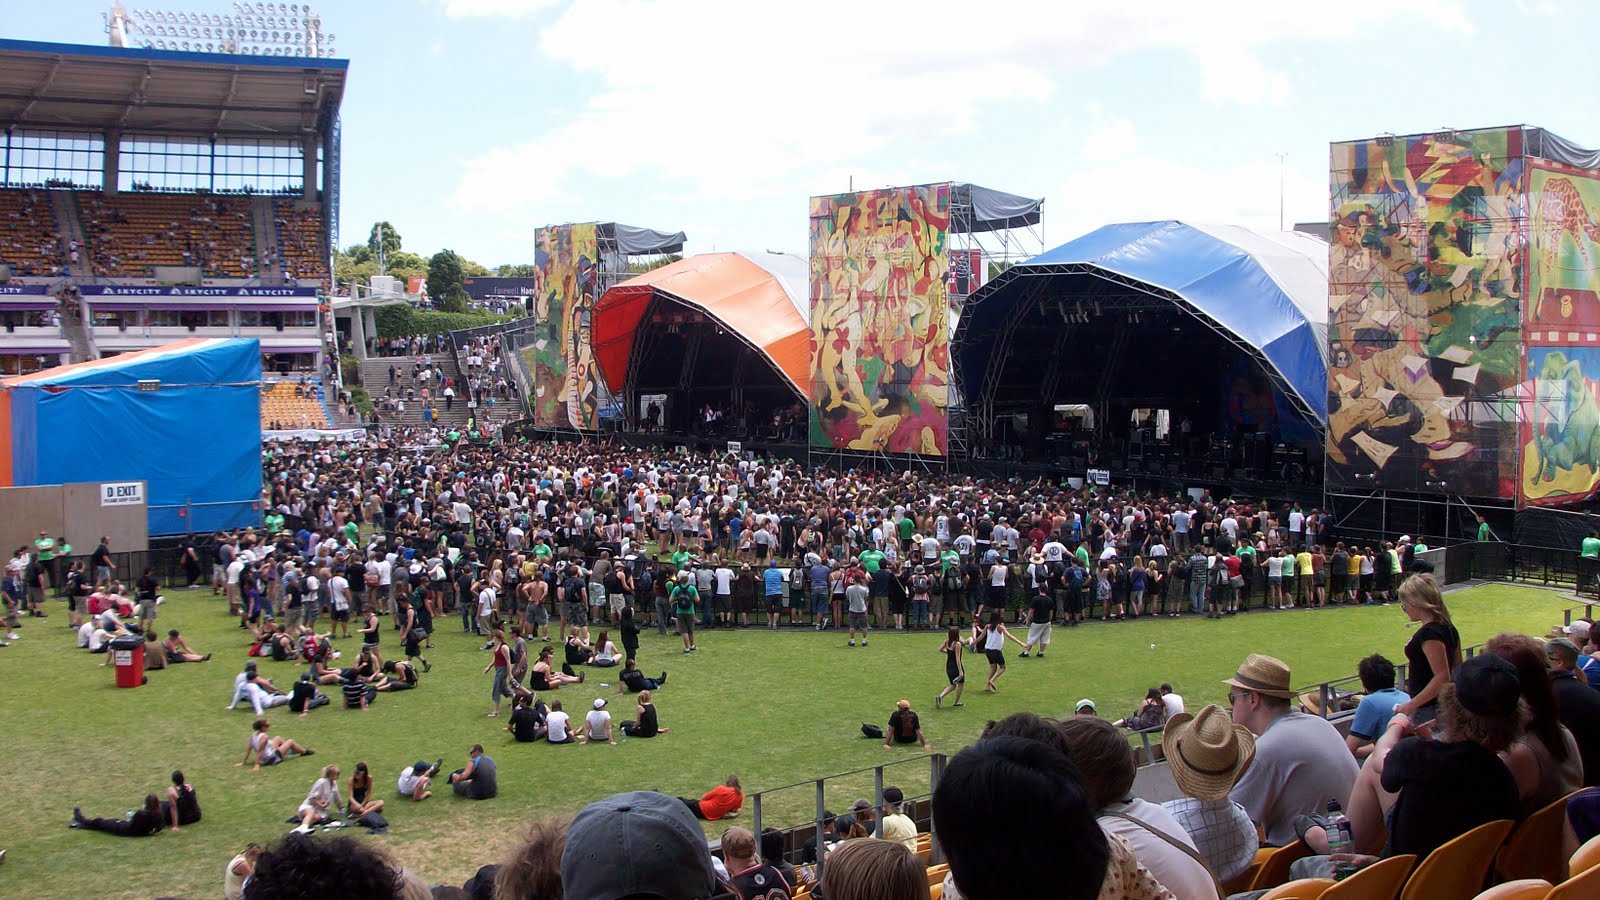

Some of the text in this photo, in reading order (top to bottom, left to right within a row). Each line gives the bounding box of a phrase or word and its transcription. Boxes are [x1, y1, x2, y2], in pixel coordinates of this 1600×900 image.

[494, 287, 519, 295] Farewell
[107, 485, 137, 497] D EXIT
